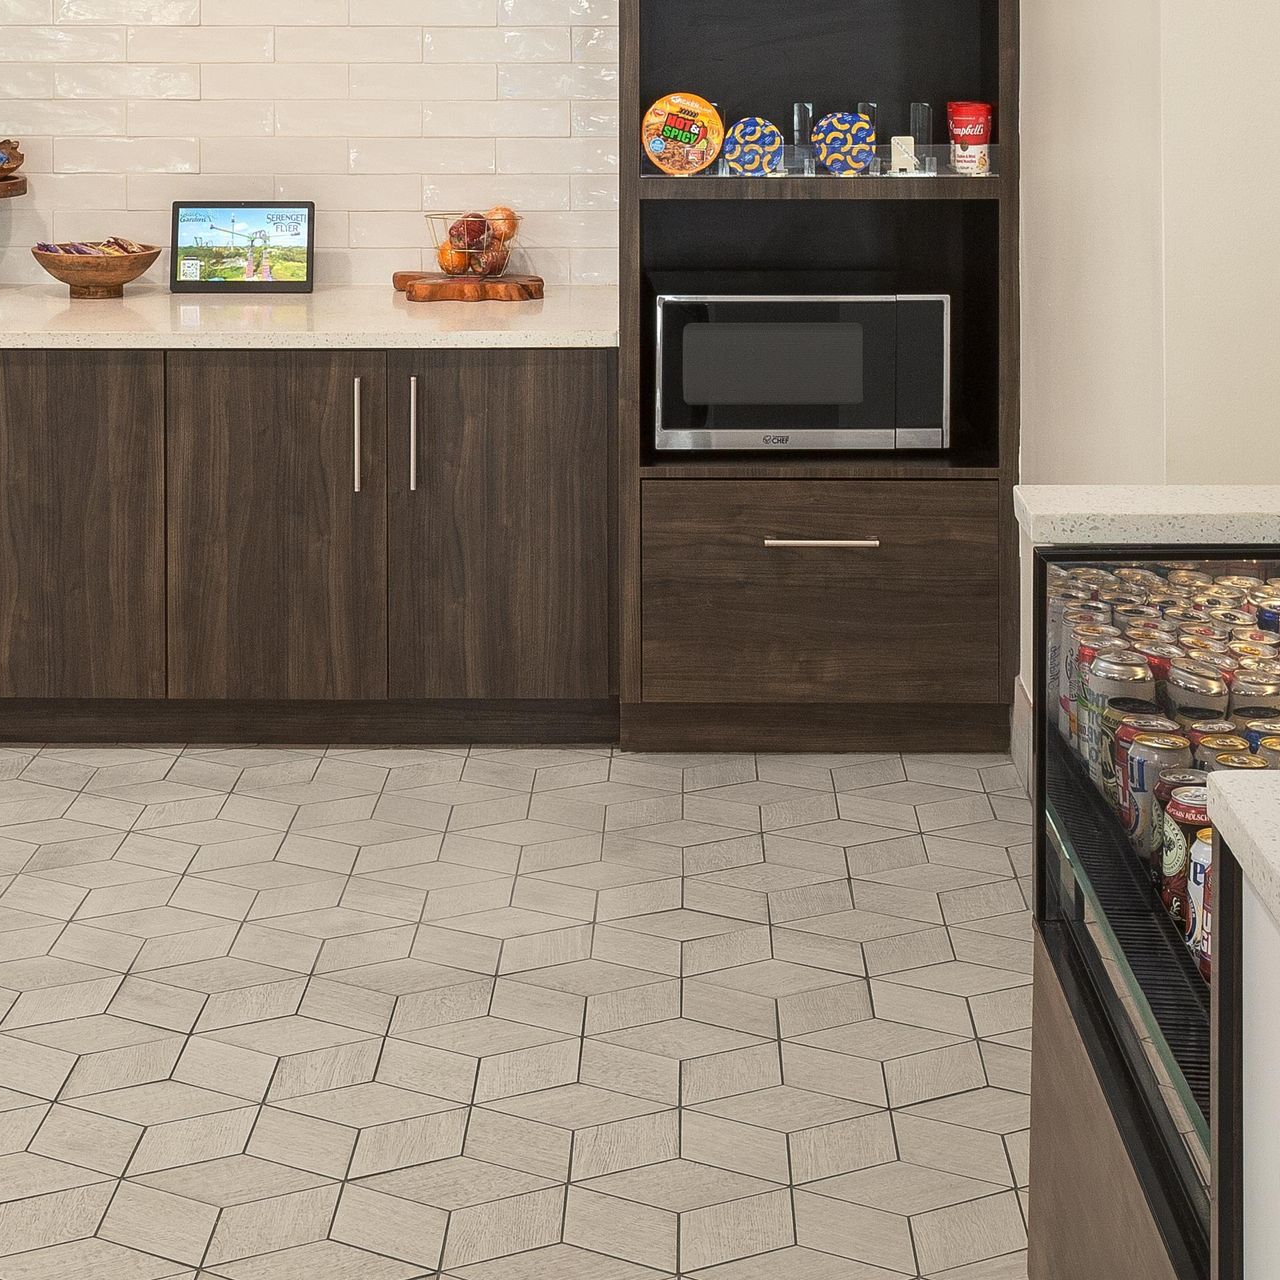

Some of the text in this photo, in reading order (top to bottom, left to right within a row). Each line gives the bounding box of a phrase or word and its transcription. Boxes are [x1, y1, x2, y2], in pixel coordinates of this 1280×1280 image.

[666, 114, 694, 131] HOT
[662, 125, 698, 144] SPICY
[266, 213, 306, 224] SERENGETI
